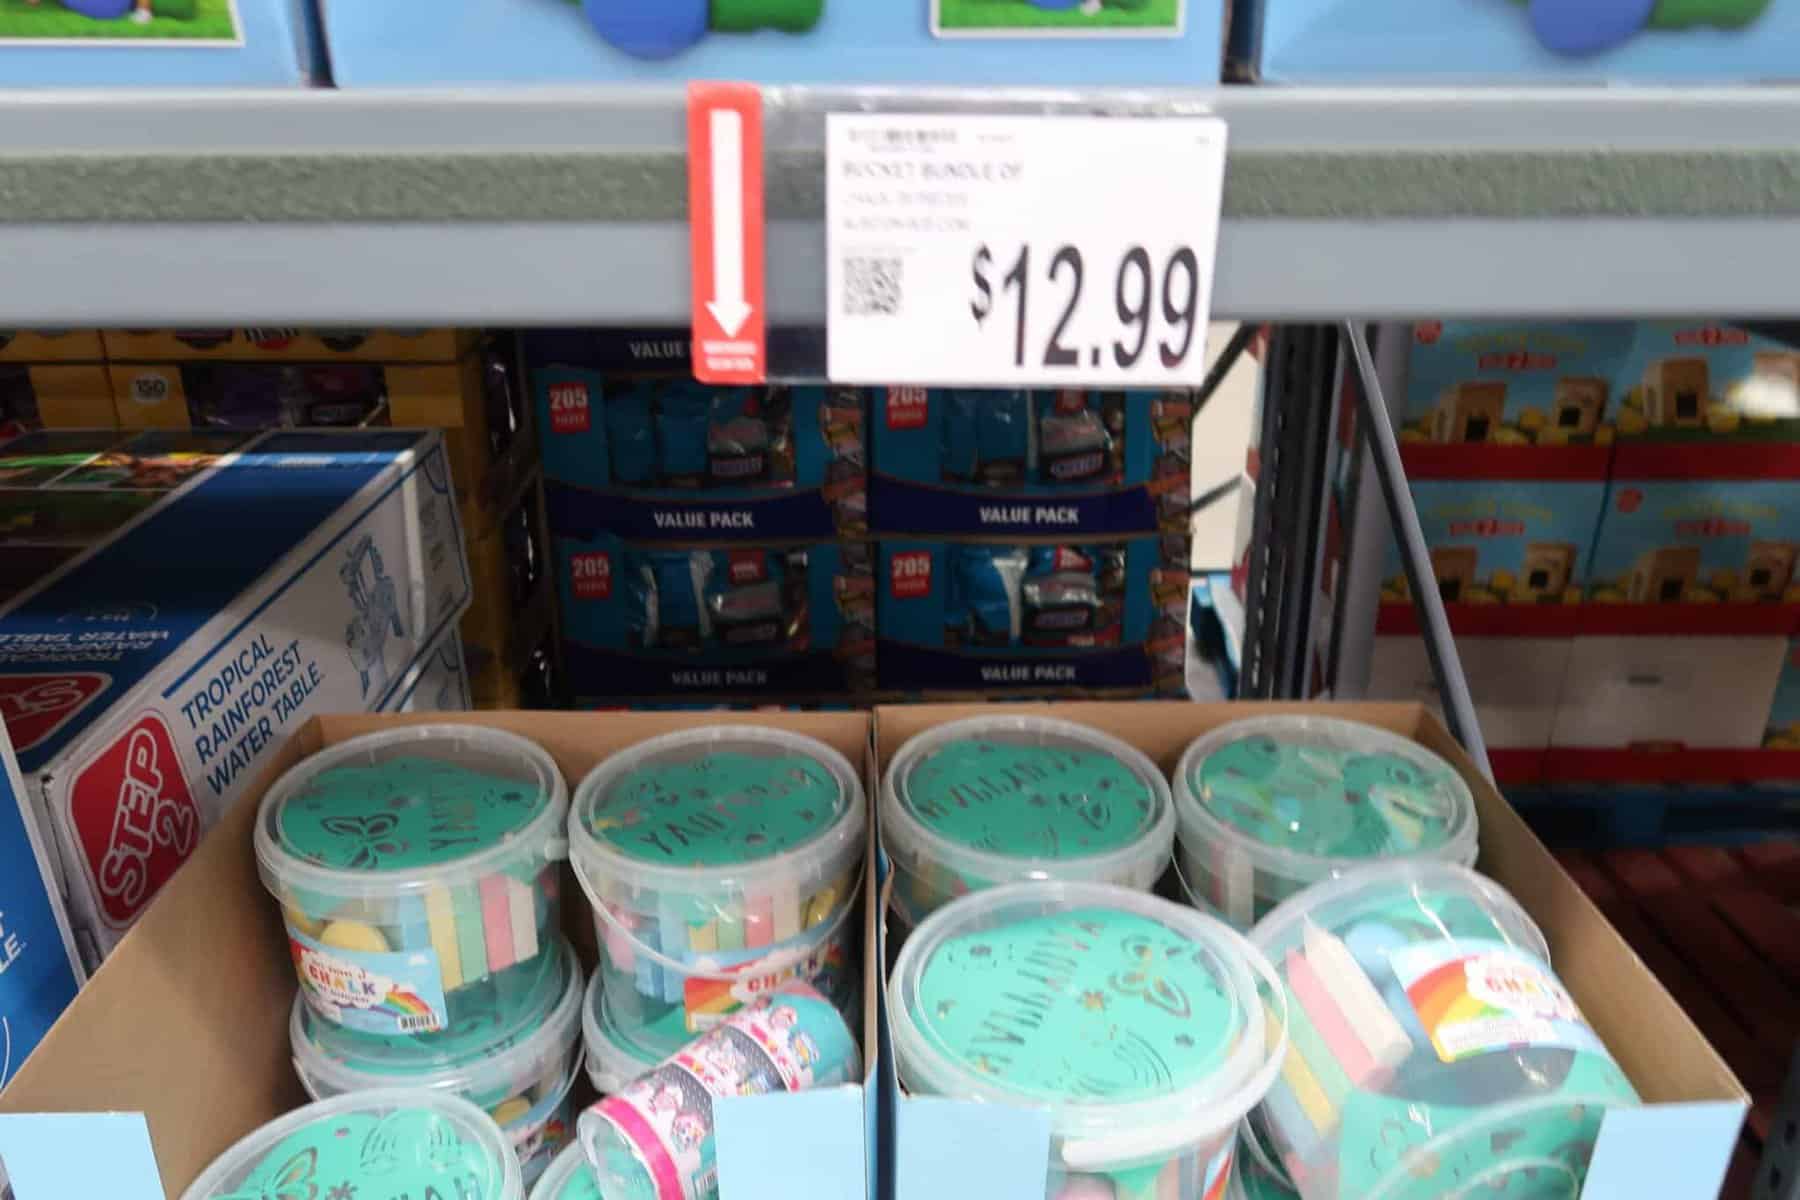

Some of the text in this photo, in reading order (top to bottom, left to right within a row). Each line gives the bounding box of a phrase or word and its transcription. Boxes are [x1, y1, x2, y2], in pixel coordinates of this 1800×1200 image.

[969, 244, 1199, 369] $12.99
[629, 341, 685, 358] VALUE
[654, 511, 754, 528] VALUE PACK
[979, 507, 1079, 524] VALUE PACK
[181, 633, 275, 729] TROPICAL
[672, 670, 767, 685] VALUE PACK
[981, 665, 1077, 681] VALUE PACK
[194, 640, 302, 765] RAINFOREST
[207, 660, 321, 796] WATER TABLE
[101, 728, 163, 907] STEP
[154, 799, 194, 857] 2
[308, 964, 377, 995] CHALK
